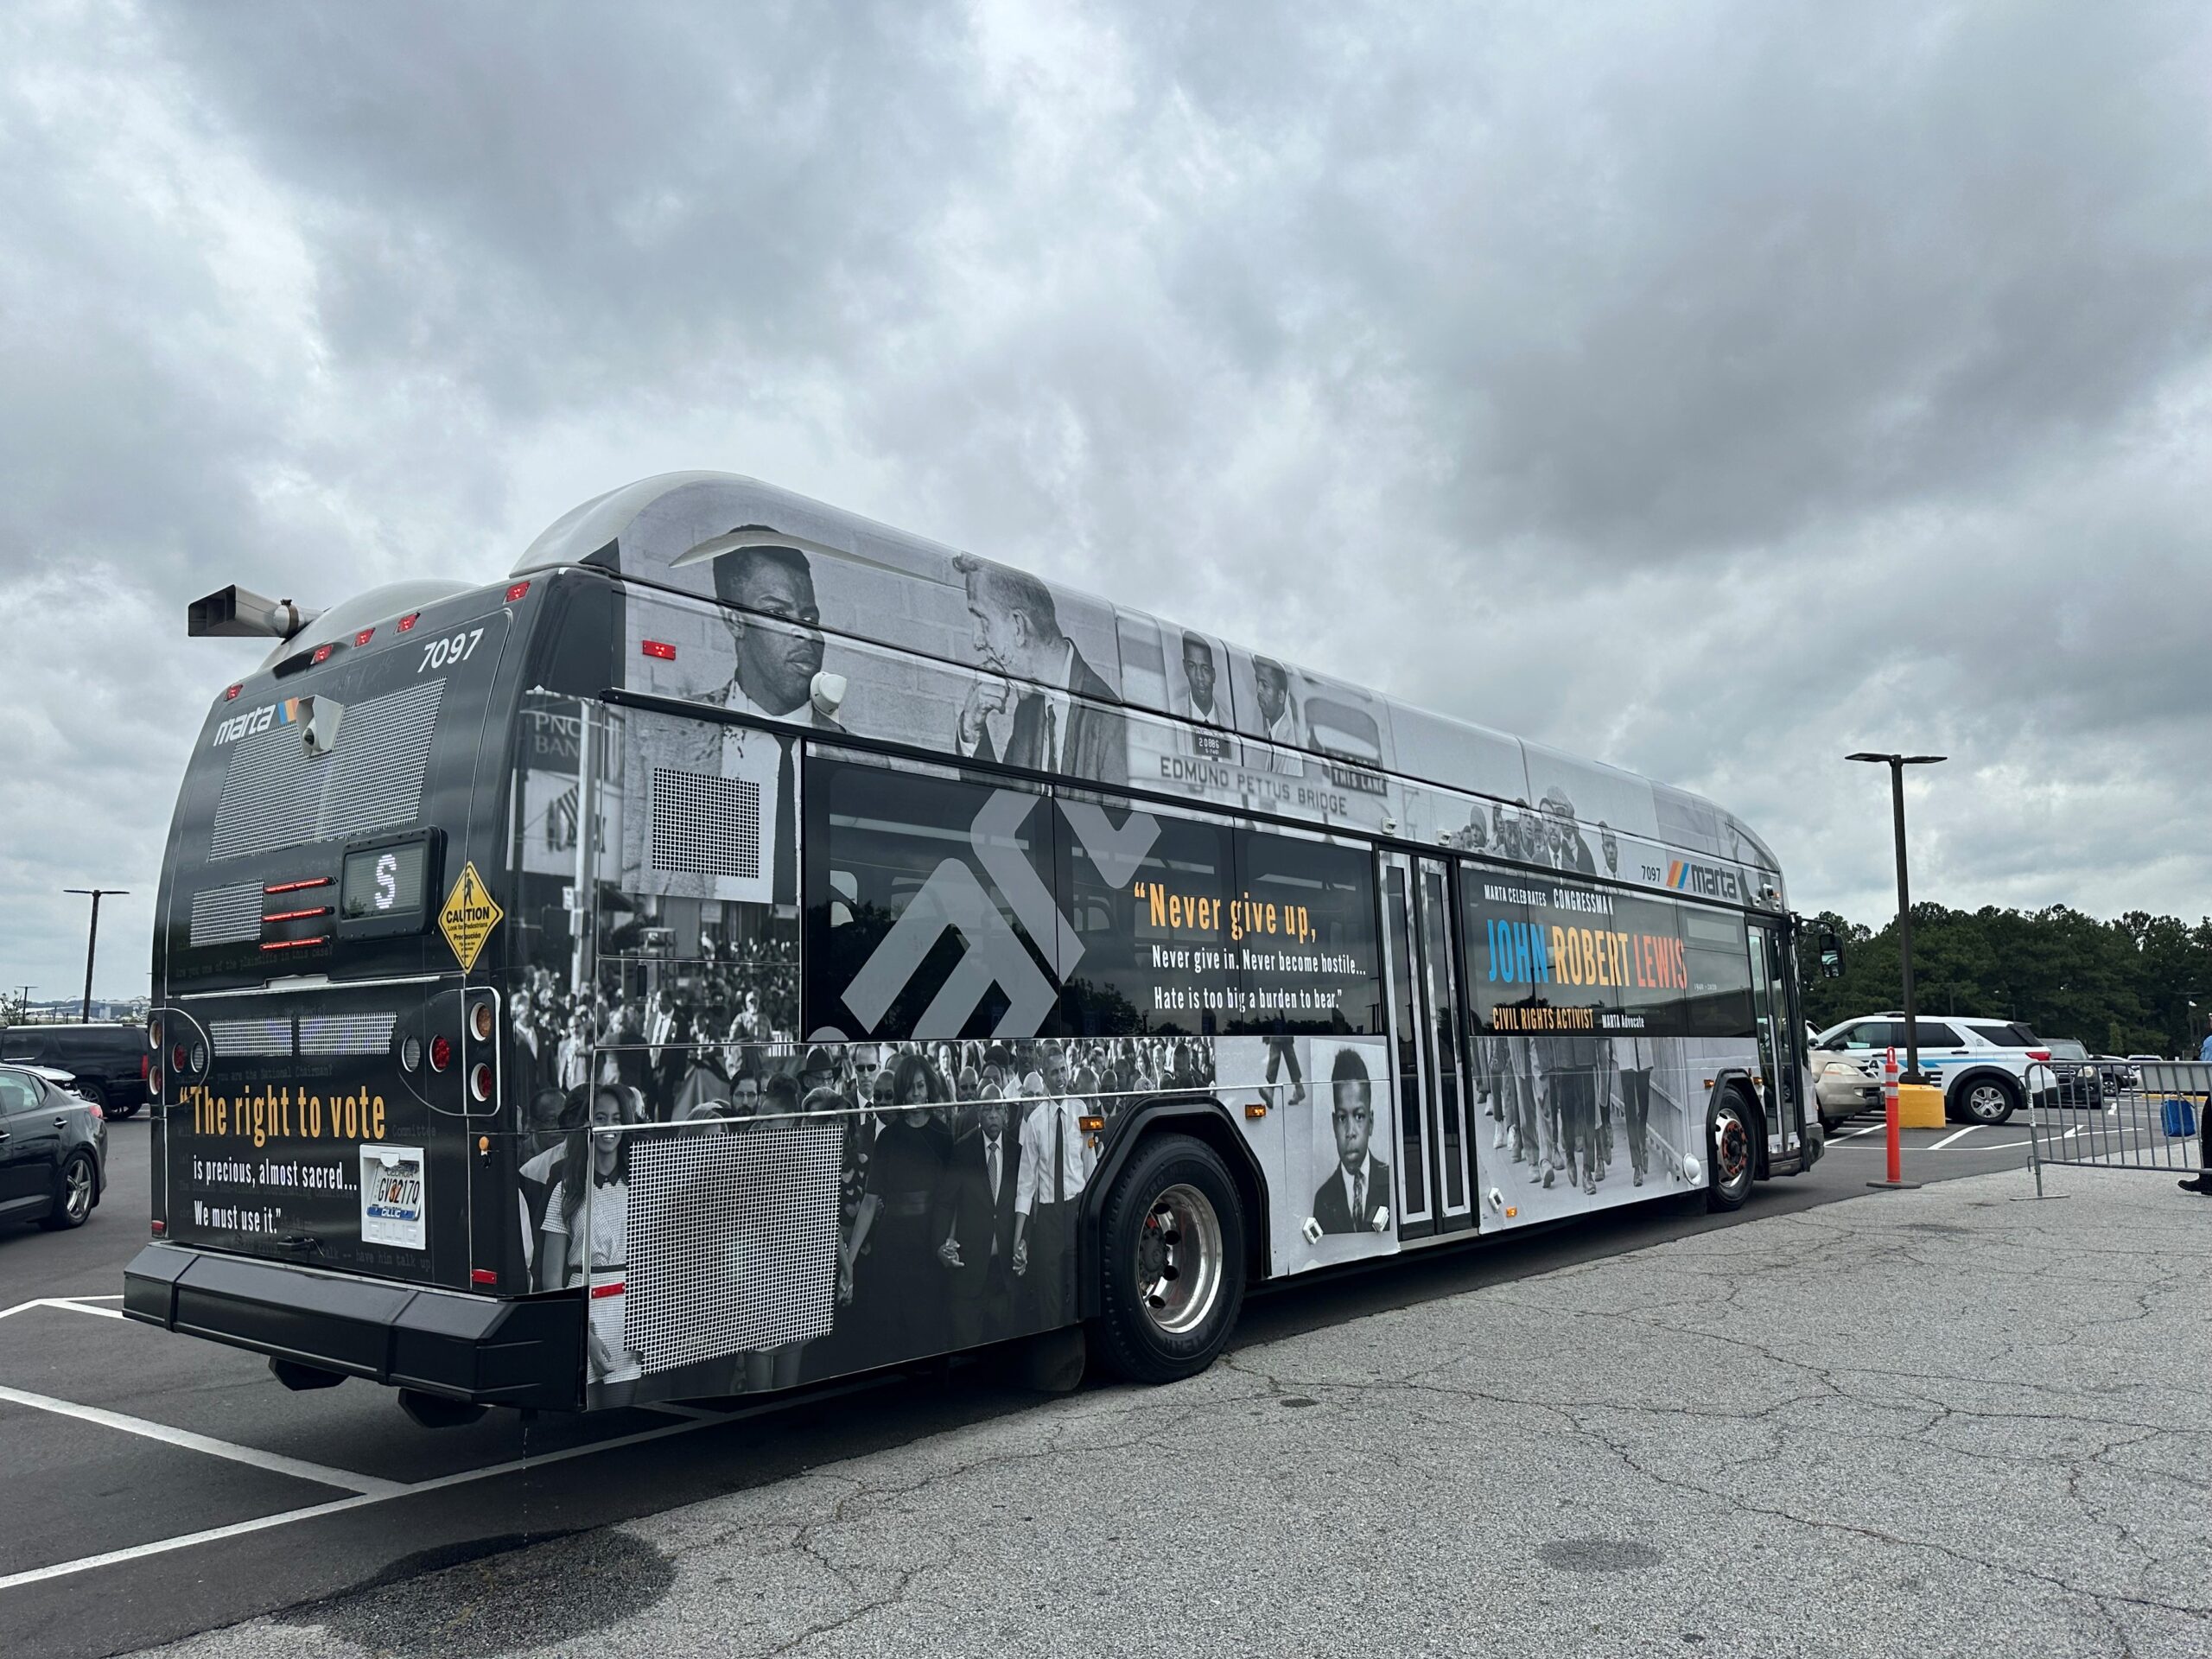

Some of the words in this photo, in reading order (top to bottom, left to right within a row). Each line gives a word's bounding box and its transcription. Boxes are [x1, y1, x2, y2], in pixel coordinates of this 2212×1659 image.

[417, 628, 484, 673] 7097
[213, 704, 276, 747] marta
[535, 735, 580, 758] BAN
[1160, 756, 1230, 787] EDMUND
[1237, 773, 1290, 800] PETTUS
[1298, 788, 1348, 816] BRIDGE
[375, 854, 397, 910] S
[1642, 865, 1661, 882] 7097
[1691, 864, 1738, 899] marta
[1484, 884, 1507, 903] MARTA
[1508, 887, 1547, 907] CELEBRATES
[1553, 888, 1613, 915] CONGRESSMAN
[446, 906, 490, 924] CAUTION
[1230, 892, 1277, 940] give
[1285, 904, 1317, 944] up,
[1153, 946, 1189, 969] Never
[1194, 950, 1220, 976] give
[1224, 949, 1240, 970] in.
[1243, 953, 1275, 973] Never
[1279, 954, 1319, 974] become
[1487, 919, 1548, 983] JOHN
[1553, 926, 1630, 987] ROBERT
[1633, 934, 1688, 989] LEWIS
[1154, 987, 1185, 1010] Hate
[1188, 987, 1200, 1010] is
[1204, 989, 1224, 1010] too
[1227, 987, 1246, 1013] big
[1249, 992, 1256, 1009] a
[1259, 988, 1297, 1009] burden
[1300, 989, 1311, 1009] to
[1493, 1007, 1519, 1030] CIVIL
[1522, 1007, 1554, 1030] RIGHTS
[1556, 1007, 1593, 1029] ACTIVIST
[1601, 1014, 1620, 1028] MARTA
[1621, 1014, 1644, 1028] Advocate
[234, 1084, 289, 1147] right
[297, 1086, 320, 1138] to
[329, 1085, 386, 1140] vote
[194, 1154, 204, 1179] is
[206, 1156, 257, 1188] precious,
[259, 1159, 299, 1187] almost
[194, 1200, 209, 1228] We
[212, 1205, 239, 1231] must
[241, 1210, 260, 1232] use
